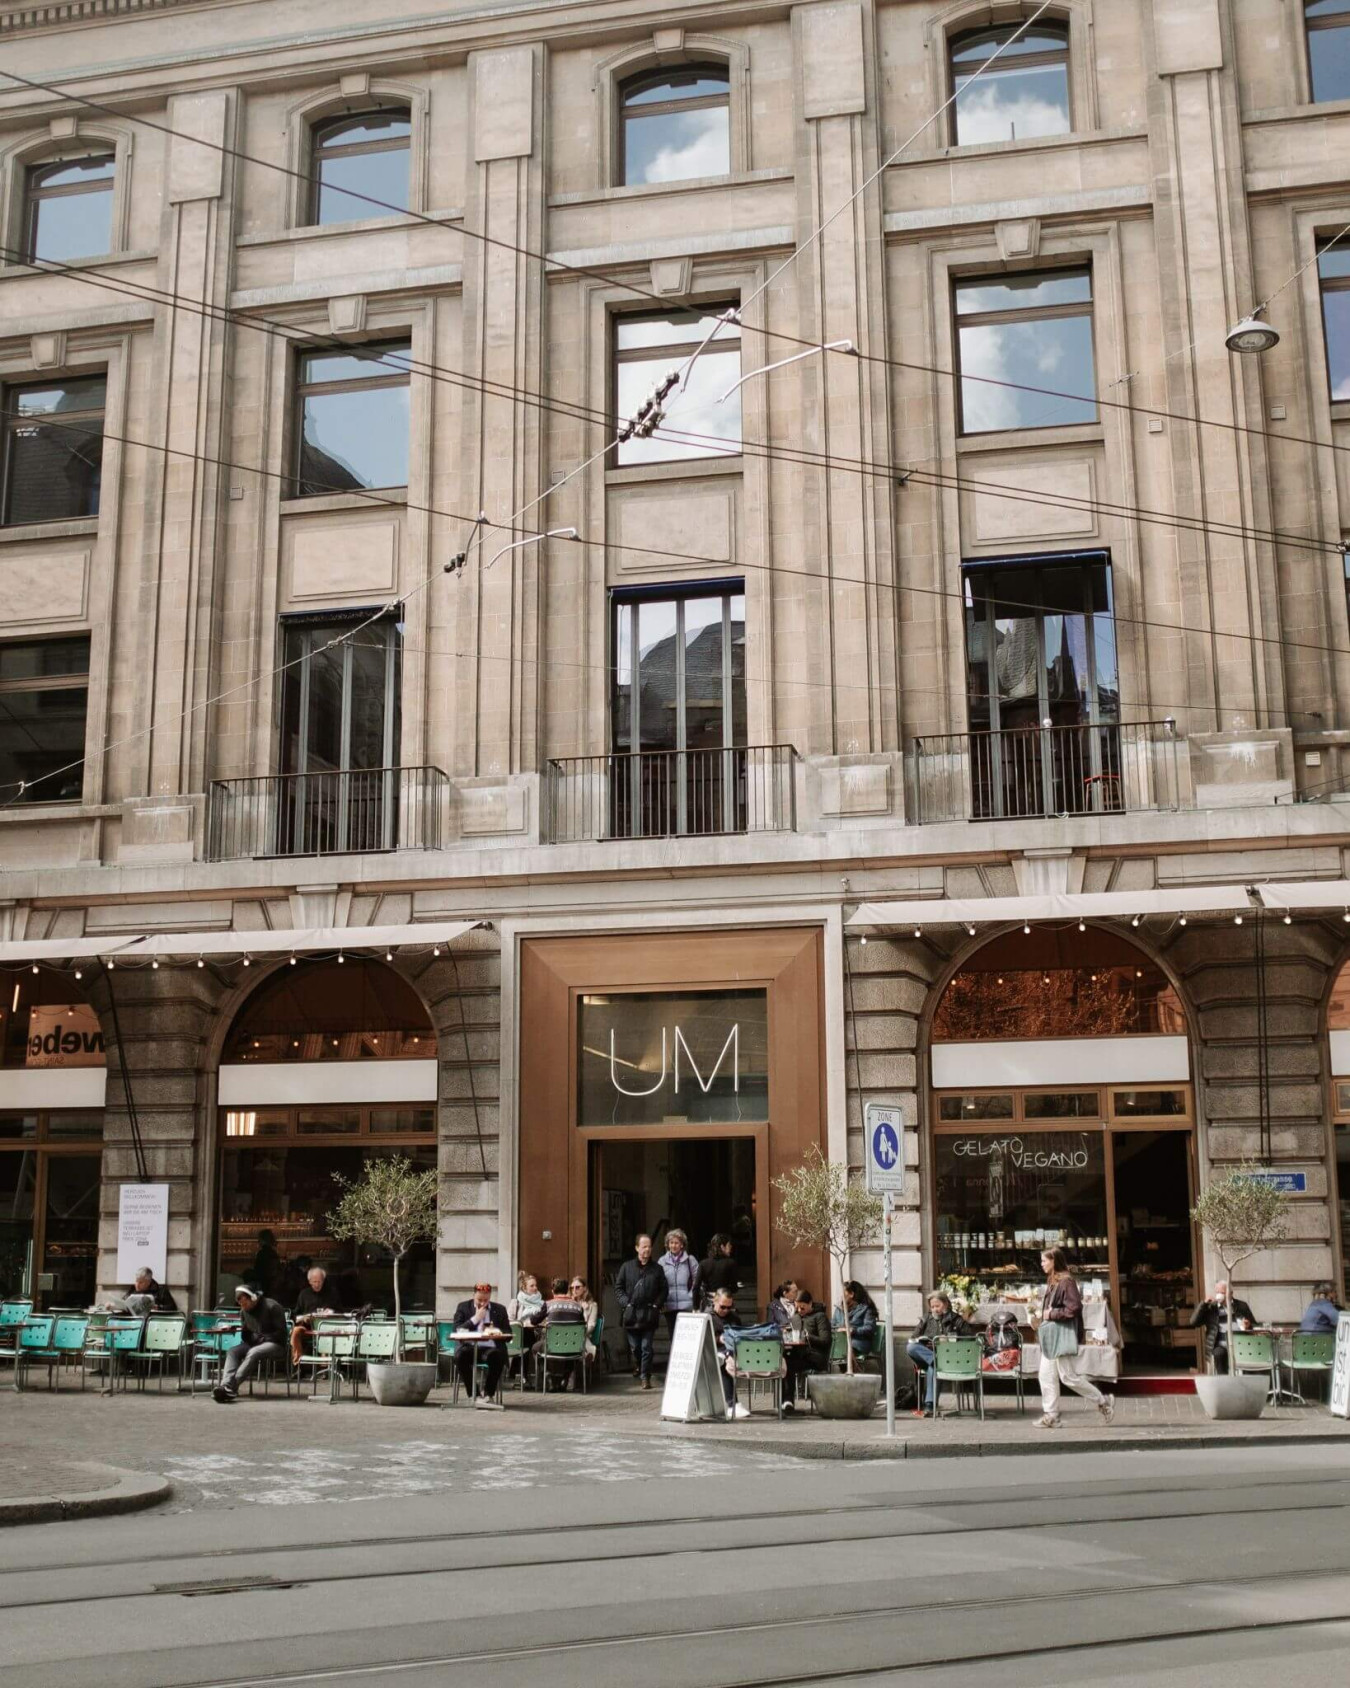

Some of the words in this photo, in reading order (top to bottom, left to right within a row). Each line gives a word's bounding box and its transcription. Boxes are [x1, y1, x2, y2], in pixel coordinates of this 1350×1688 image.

[610, 1023, 739, 1096] UM
[877, 1111, 892, 1122] ZONE
[1011, 1151, 1088, 1168] VEGANO
